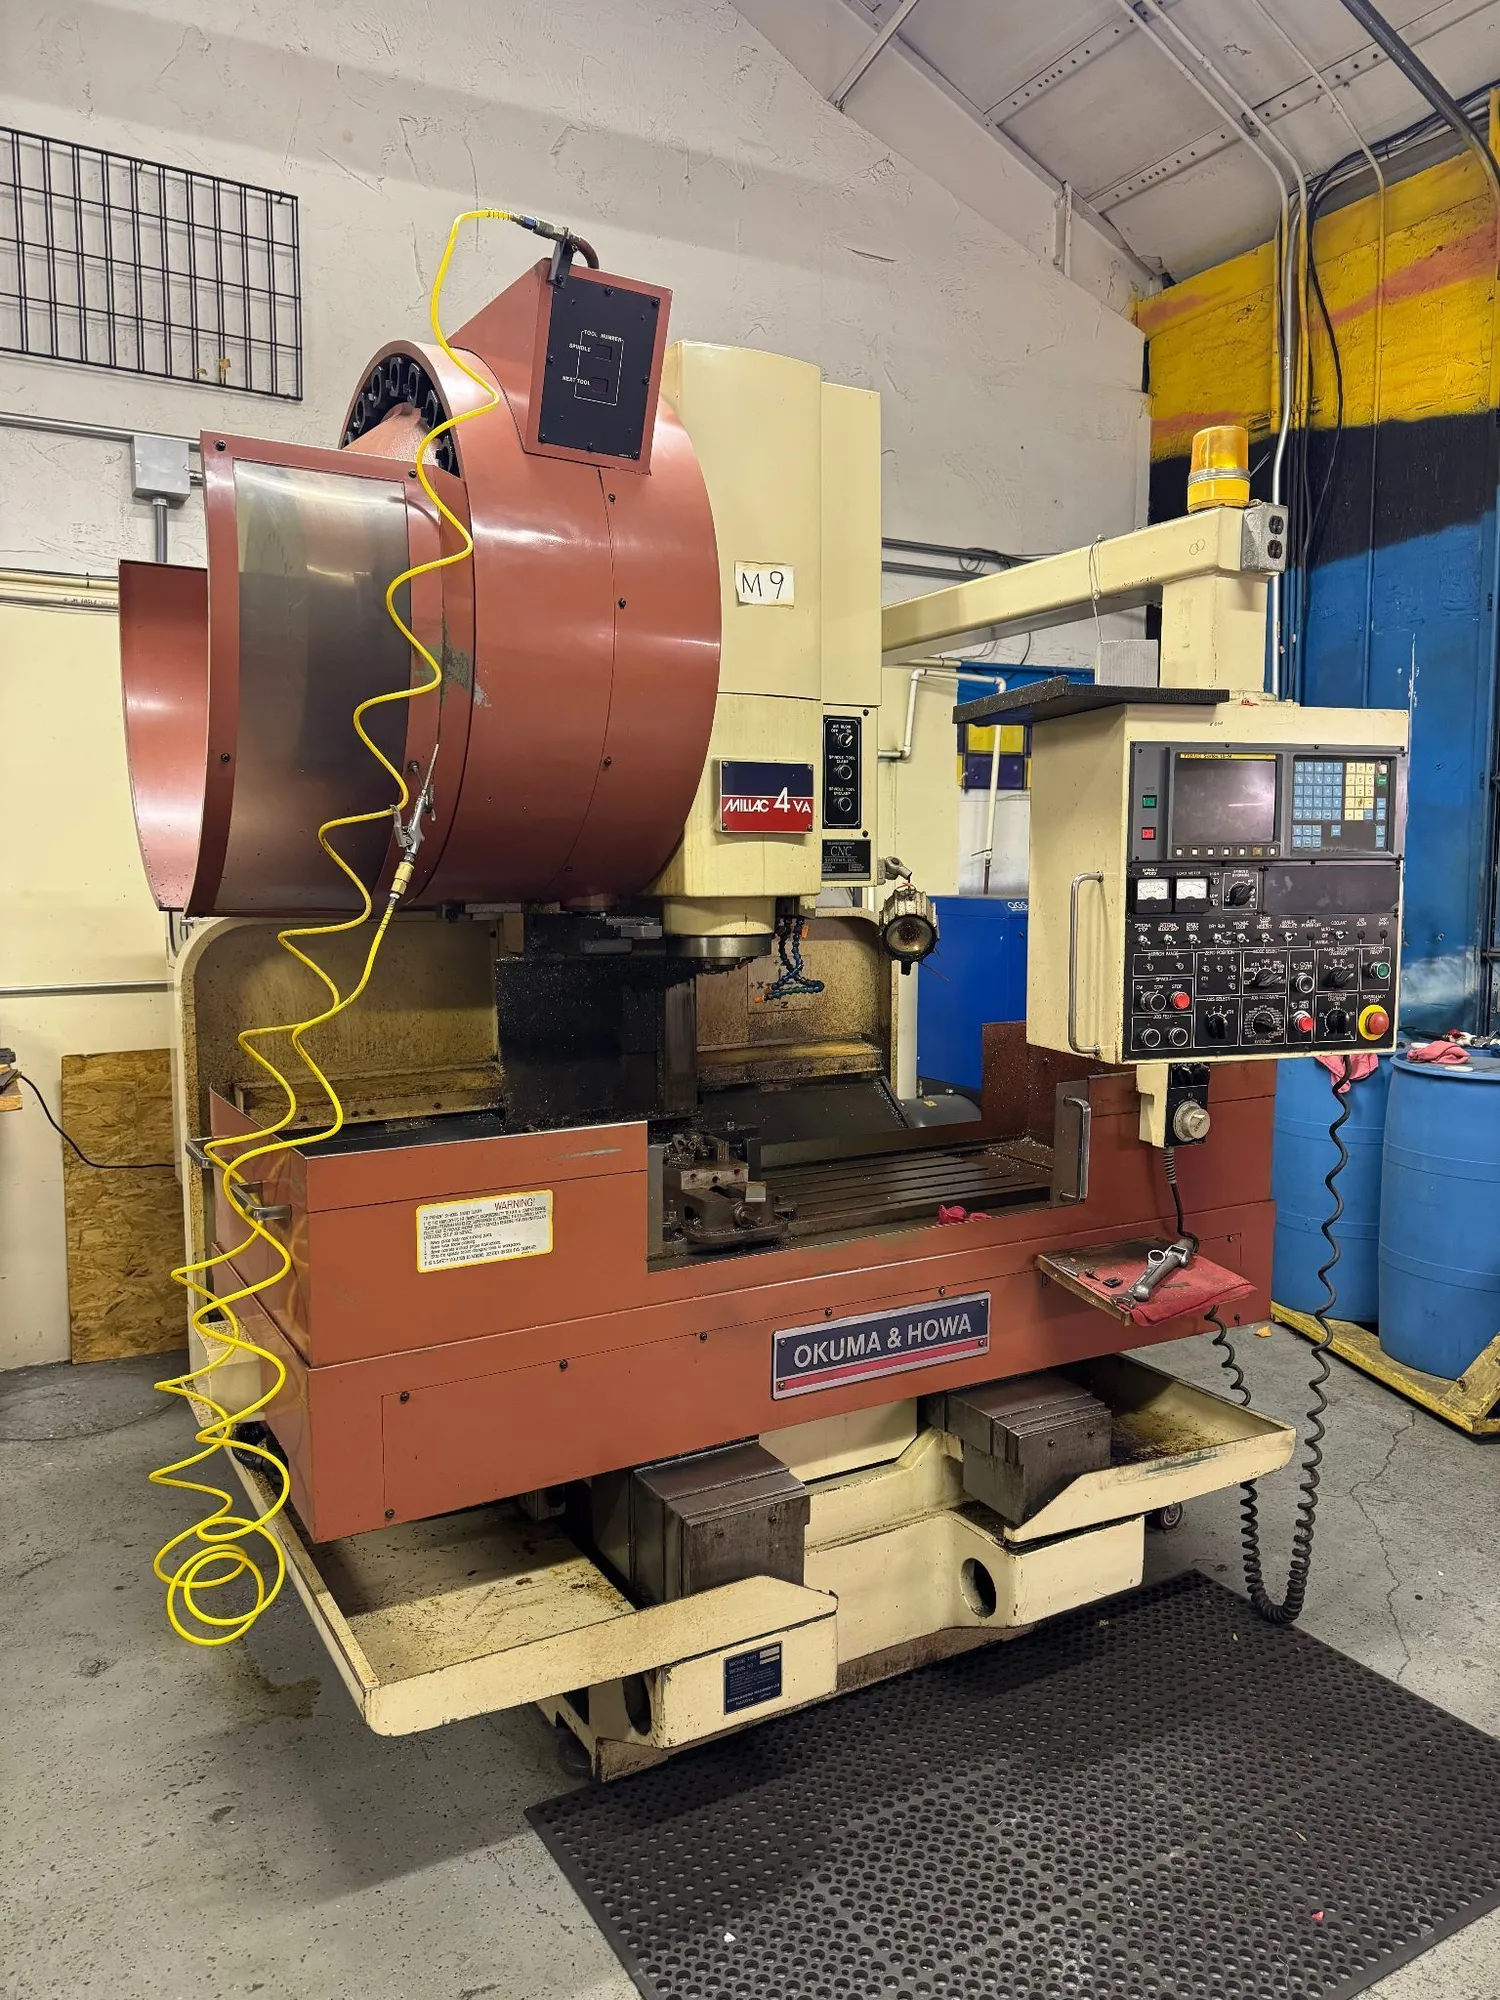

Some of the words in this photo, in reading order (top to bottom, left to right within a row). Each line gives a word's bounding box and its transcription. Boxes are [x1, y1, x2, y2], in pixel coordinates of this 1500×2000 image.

[569, 343, 591, 352] SPINDLE
[724, 798, 770, 812] MILLAC
[831, 846, 852, 856] CNC
[494, 1198, 535, 1211] WARNING!
[794, 1332, 881, 1368] OKUMA
[887, 1328, 901, 1348] &
[908, 1314, 972, 1344] HOWA
